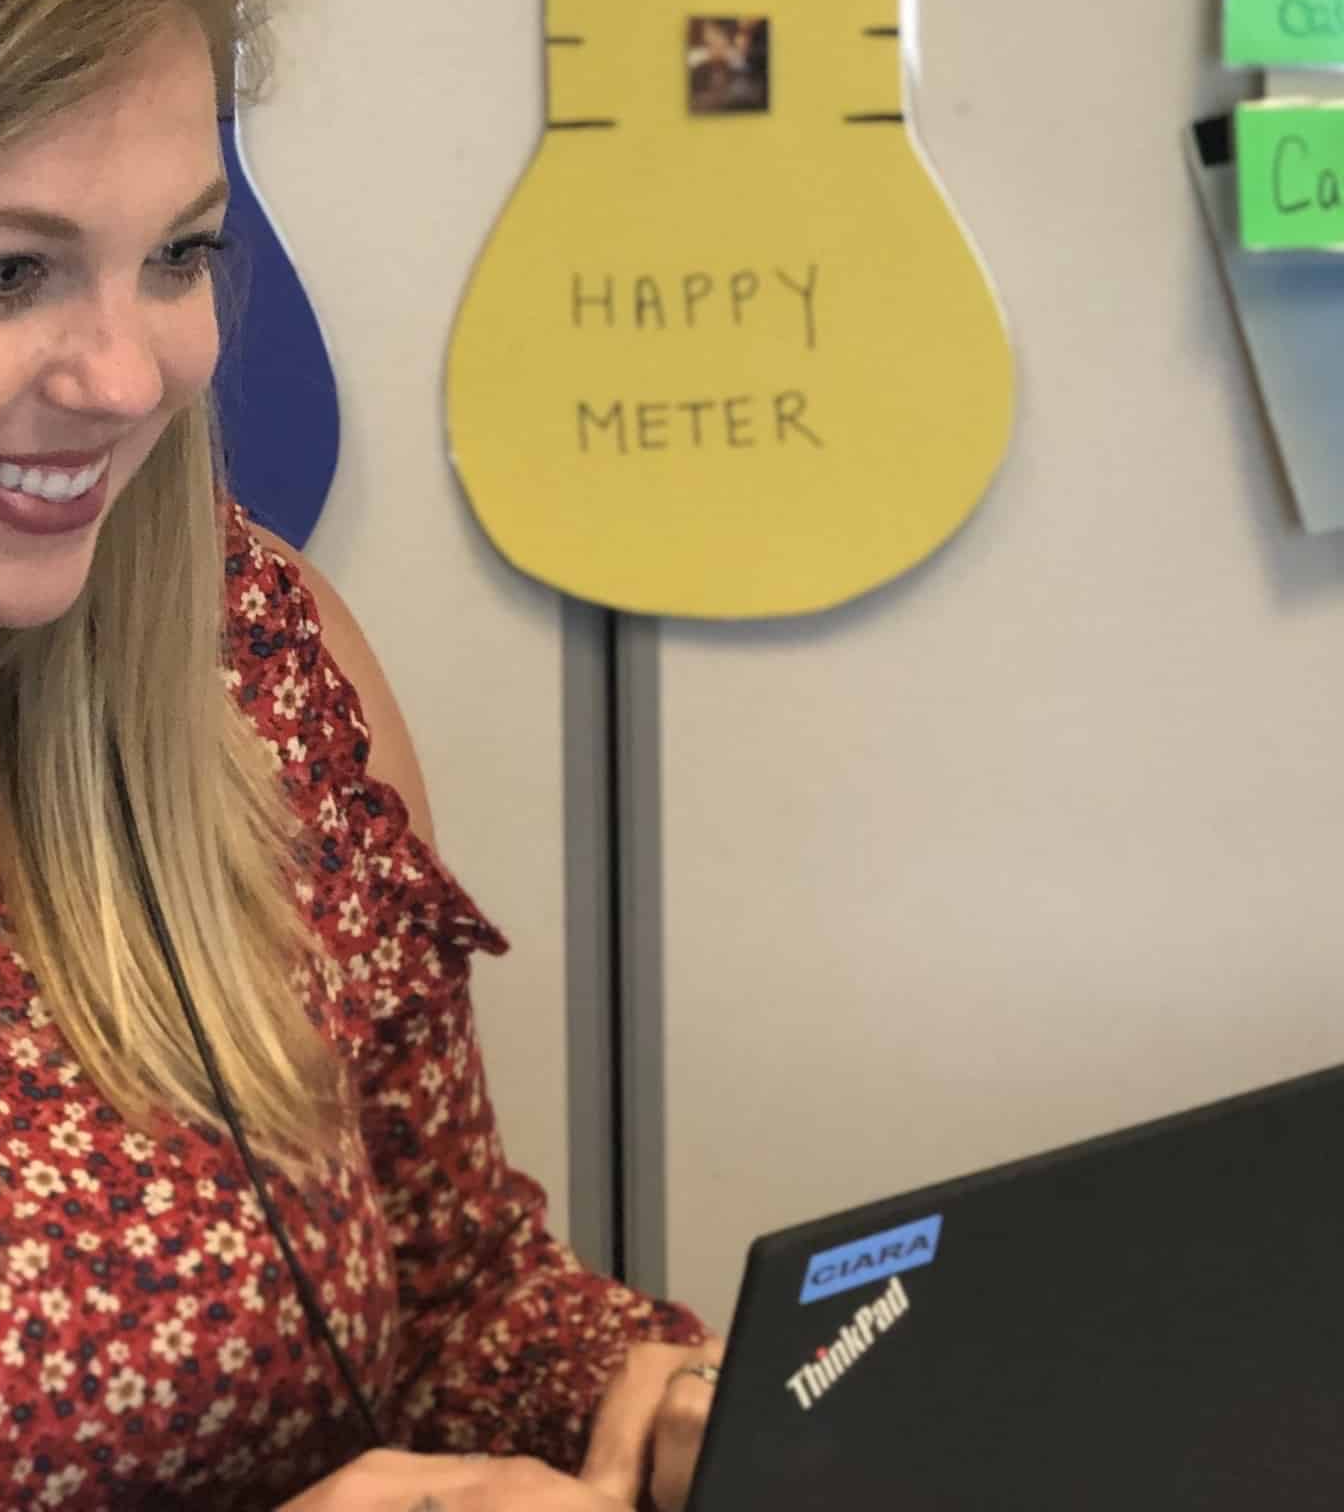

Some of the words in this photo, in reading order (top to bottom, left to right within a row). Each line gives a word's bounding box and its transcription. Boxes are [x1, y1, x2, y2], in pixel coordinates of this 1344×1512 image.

[569, 262, 820, 350] HAPPY
[575, 390, 826, 455] METER
[811, 1234, 931, 1285] CIARA
[784, 1275, 910, 1411] ThinkPad
